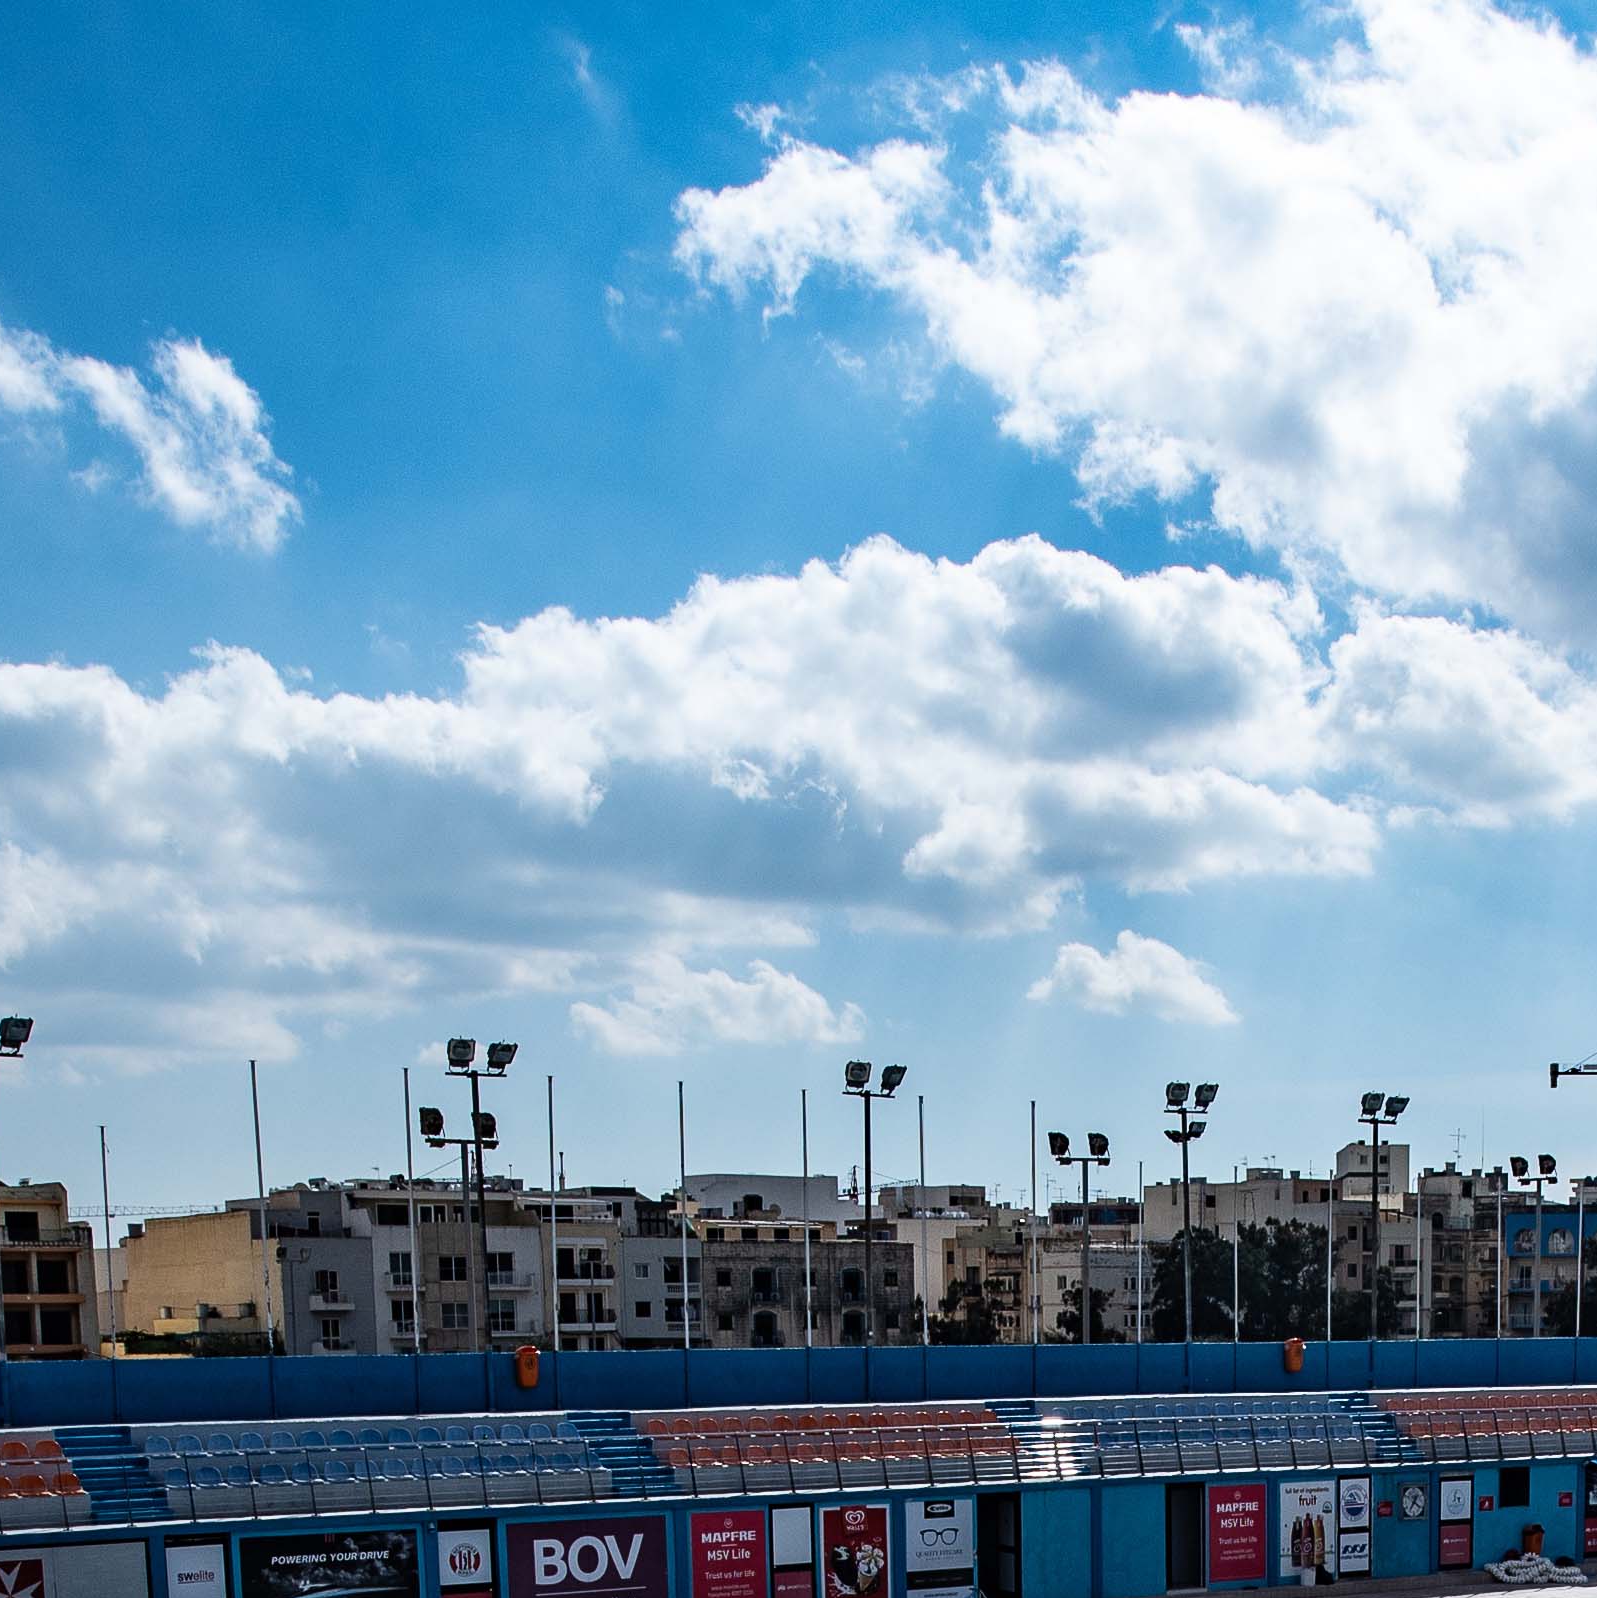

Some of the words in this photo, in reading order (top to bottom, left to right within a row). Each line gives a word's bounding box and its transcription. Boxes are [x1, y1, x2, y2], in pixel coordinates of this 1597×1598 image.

[1299, 1495, 1317, 1506] fruit
[1216, 1502, 1259, 1513] MAPFRE
[1220, 1518, 1238, 1528] MSV
[702, 1531, 757, 1543] MAPFRE
[271, 1553, 327, 1566] POWERING
[330, 1552, 359, 1562] YOUR
[358, 1550, 391, 1560] DRIVE
[533, 1533, 644, 1585] BOV
[708, 1549, 729, 1560] MSV
[731, 1547, 751, 1560] Life
[178, 1570, 215, 1582] swelite
